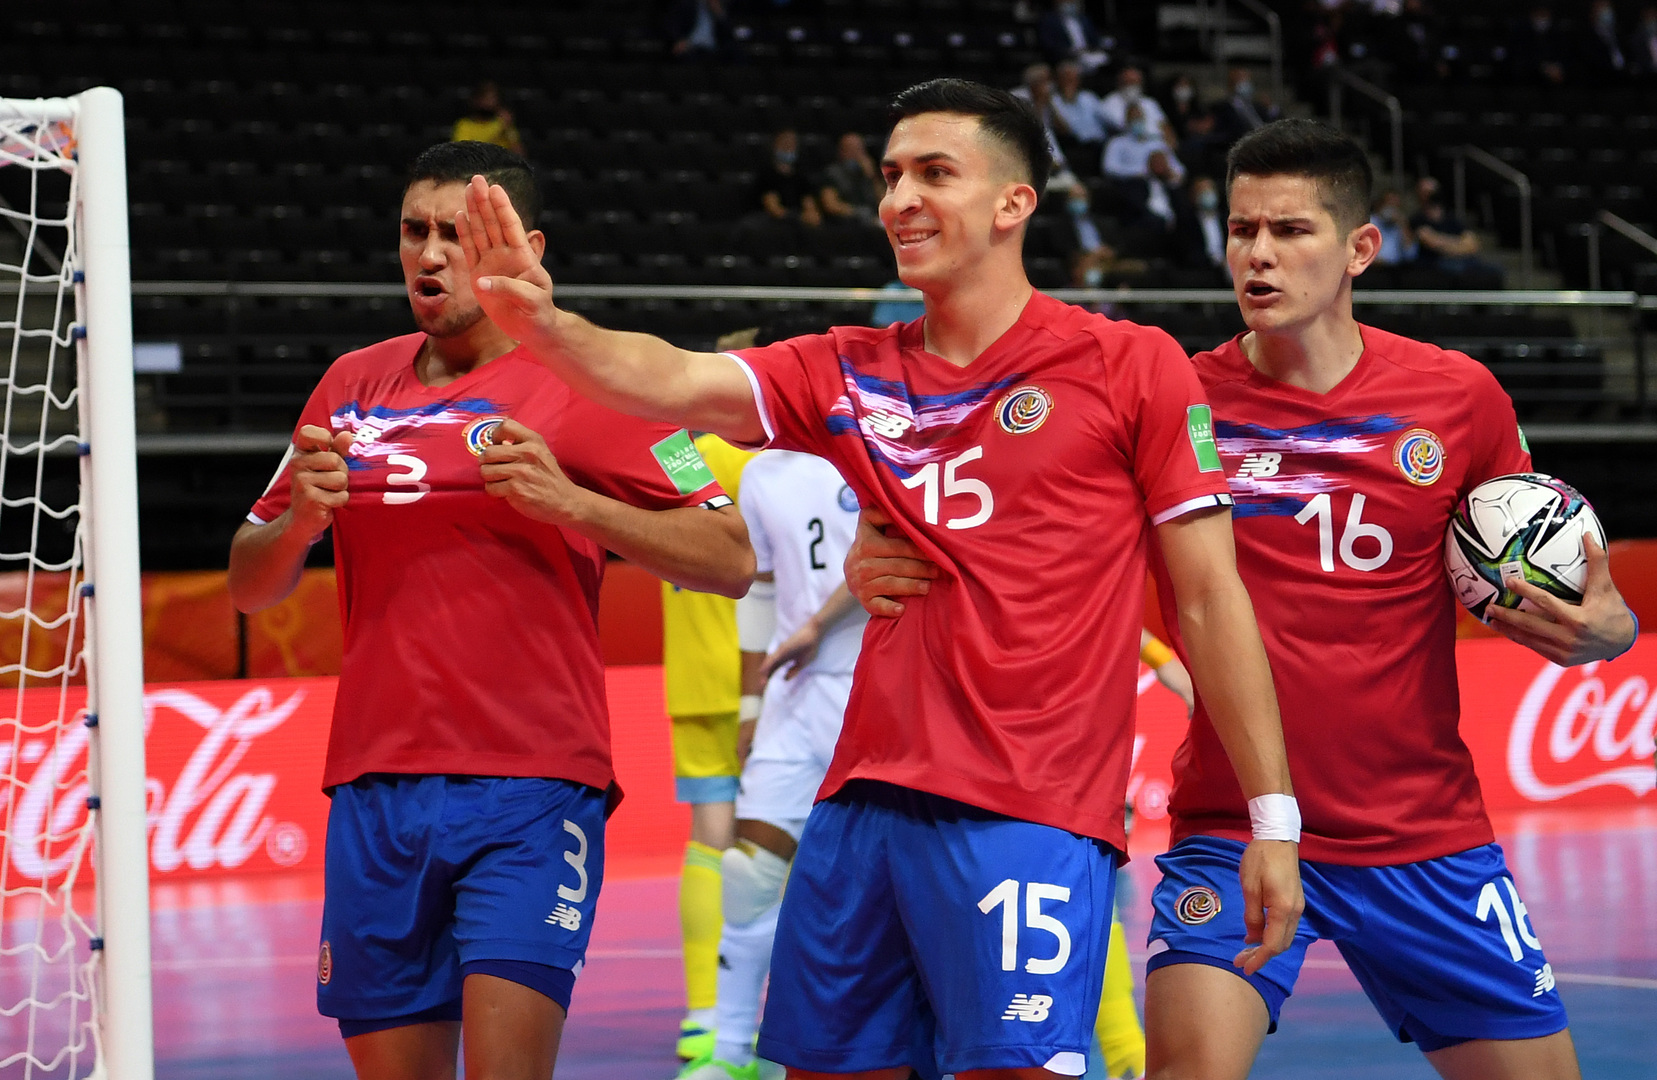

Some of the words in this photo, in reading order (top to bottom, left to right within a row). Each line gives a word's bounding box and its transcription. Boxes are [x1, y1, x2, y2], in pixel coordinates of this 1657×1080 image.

[382, 453, 431, 505] 3
[901, 445, 994, 530] 15
[807, 517, 827, 570] 2
[1294, 492, 1394, 572] 16
[556, 818, 588, 904] 3
[977, 878, 1071, 975] 15
